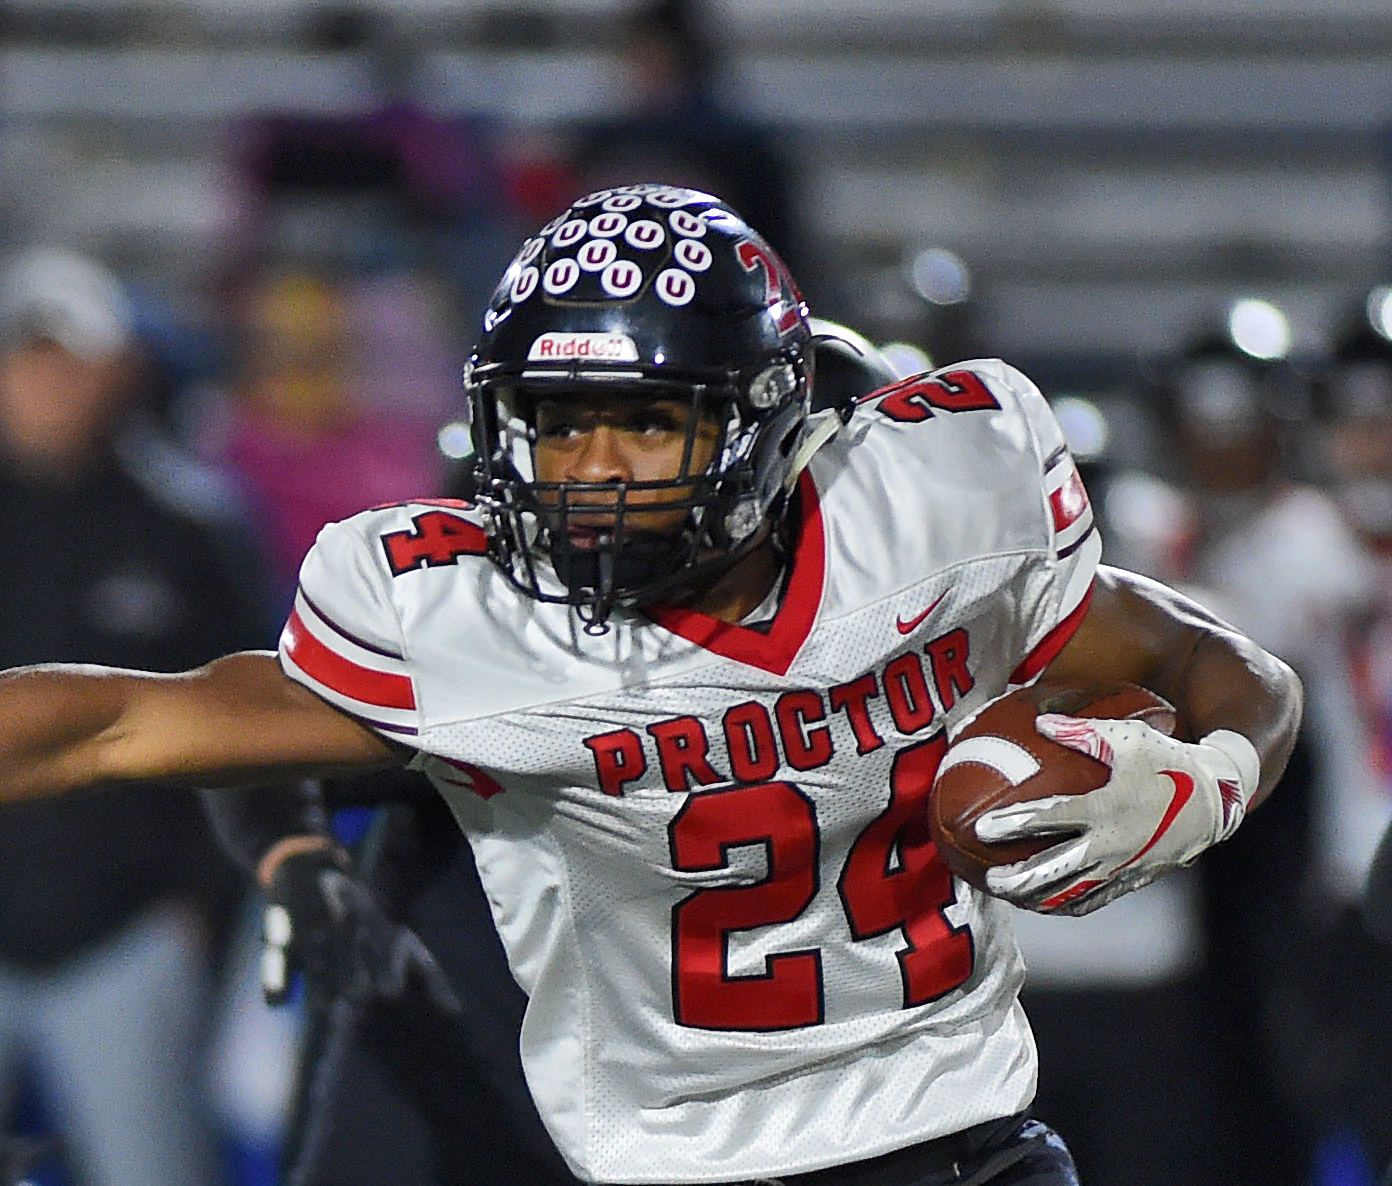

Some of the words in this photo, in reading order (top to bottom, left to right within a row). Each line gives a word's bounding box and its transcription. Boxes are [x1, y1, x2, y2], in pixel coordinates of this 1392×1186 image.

[611, 198, 633, 208] U
[559, 224, 581, 241] U
[597, 217, 620, 232] U
[634, 226, 658, 243] U
[678, 216, 699, 232] U
[586, 246, 609, 264] U
[683, 244, 704, 265] U
[516, 273, 533, 295] U
[551, 265, 572, 287] U
[611, 268, 633, 289] U
[665, 275, 687, 298] U
[583, 627, 975, 797] PROCTOR
[668, 726, 975, 1032] 24
